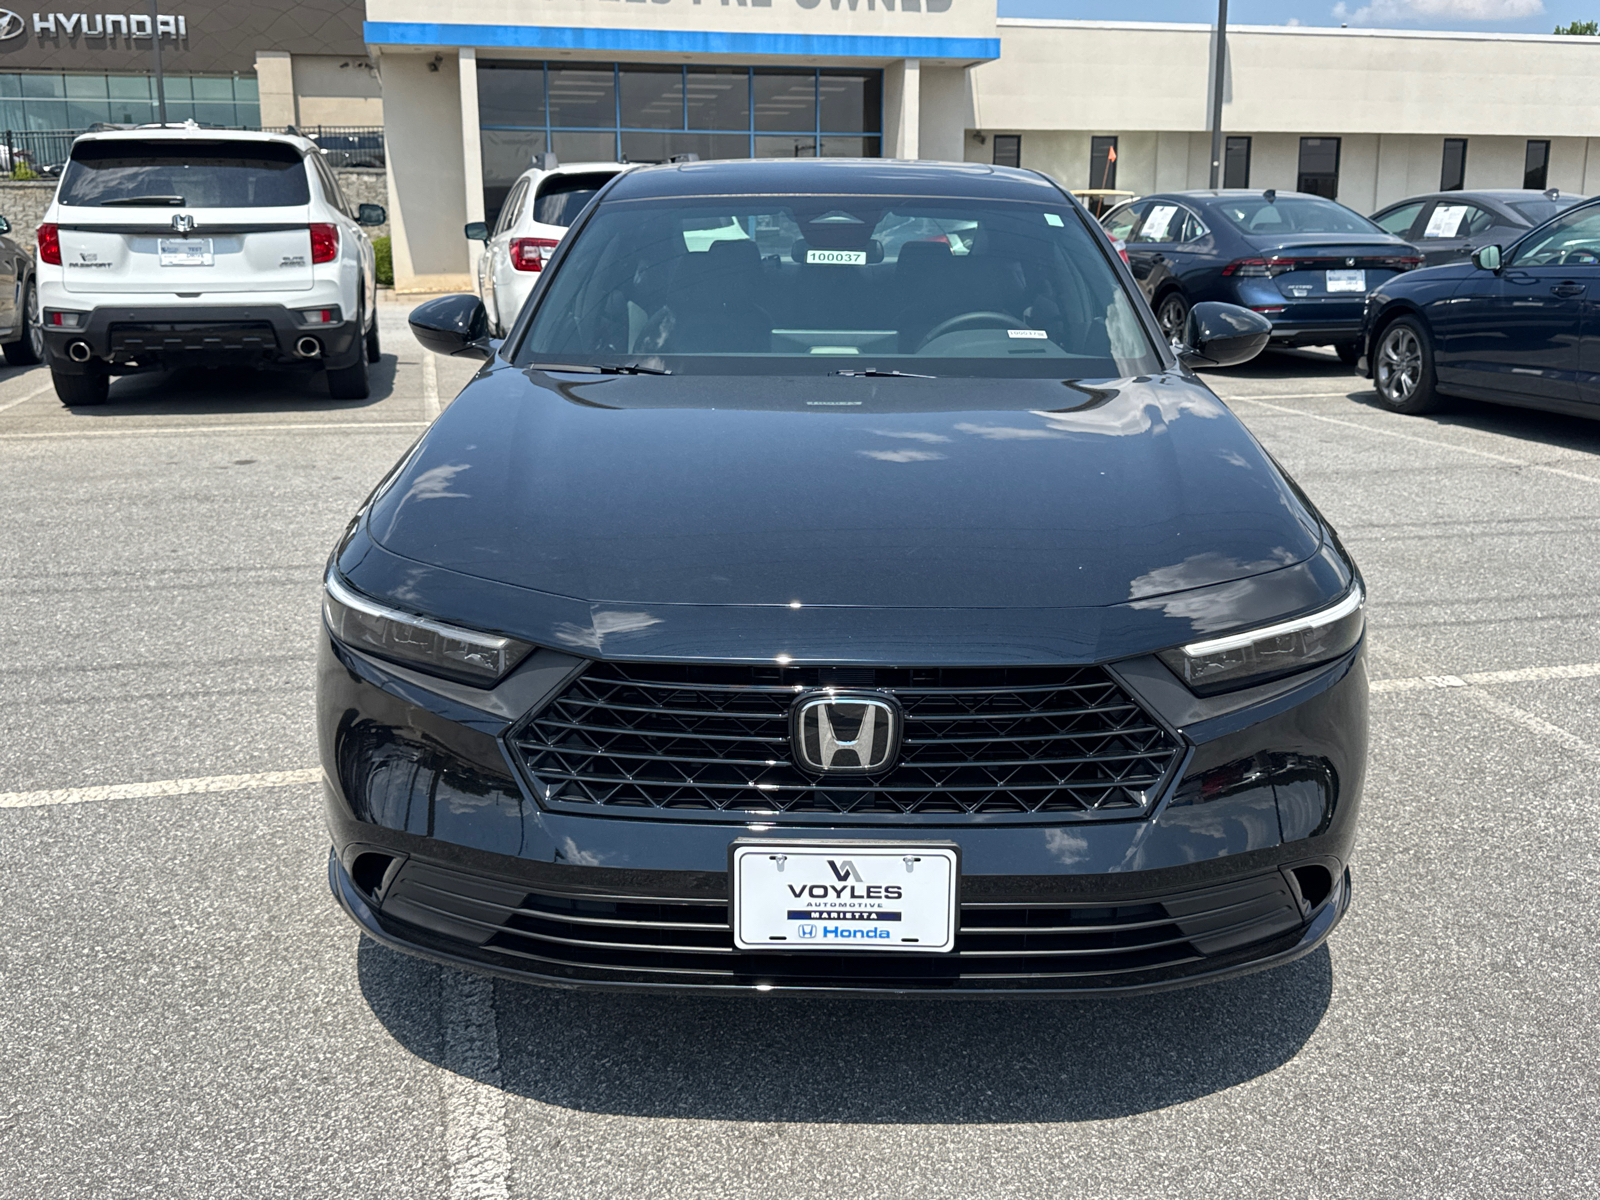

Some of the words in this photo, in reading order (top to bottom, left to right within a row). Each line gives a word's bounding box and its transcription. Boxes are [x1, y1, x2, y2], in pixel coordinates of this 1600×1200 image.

[32, 13, 187, 39] HYUNDAI
[810, 252, 862, 263] 100037
[787, 884, 903, 900] VOYLES
[810, 911, 878, 920] MARIETTA
[823, 925, 891, 939] Honda
